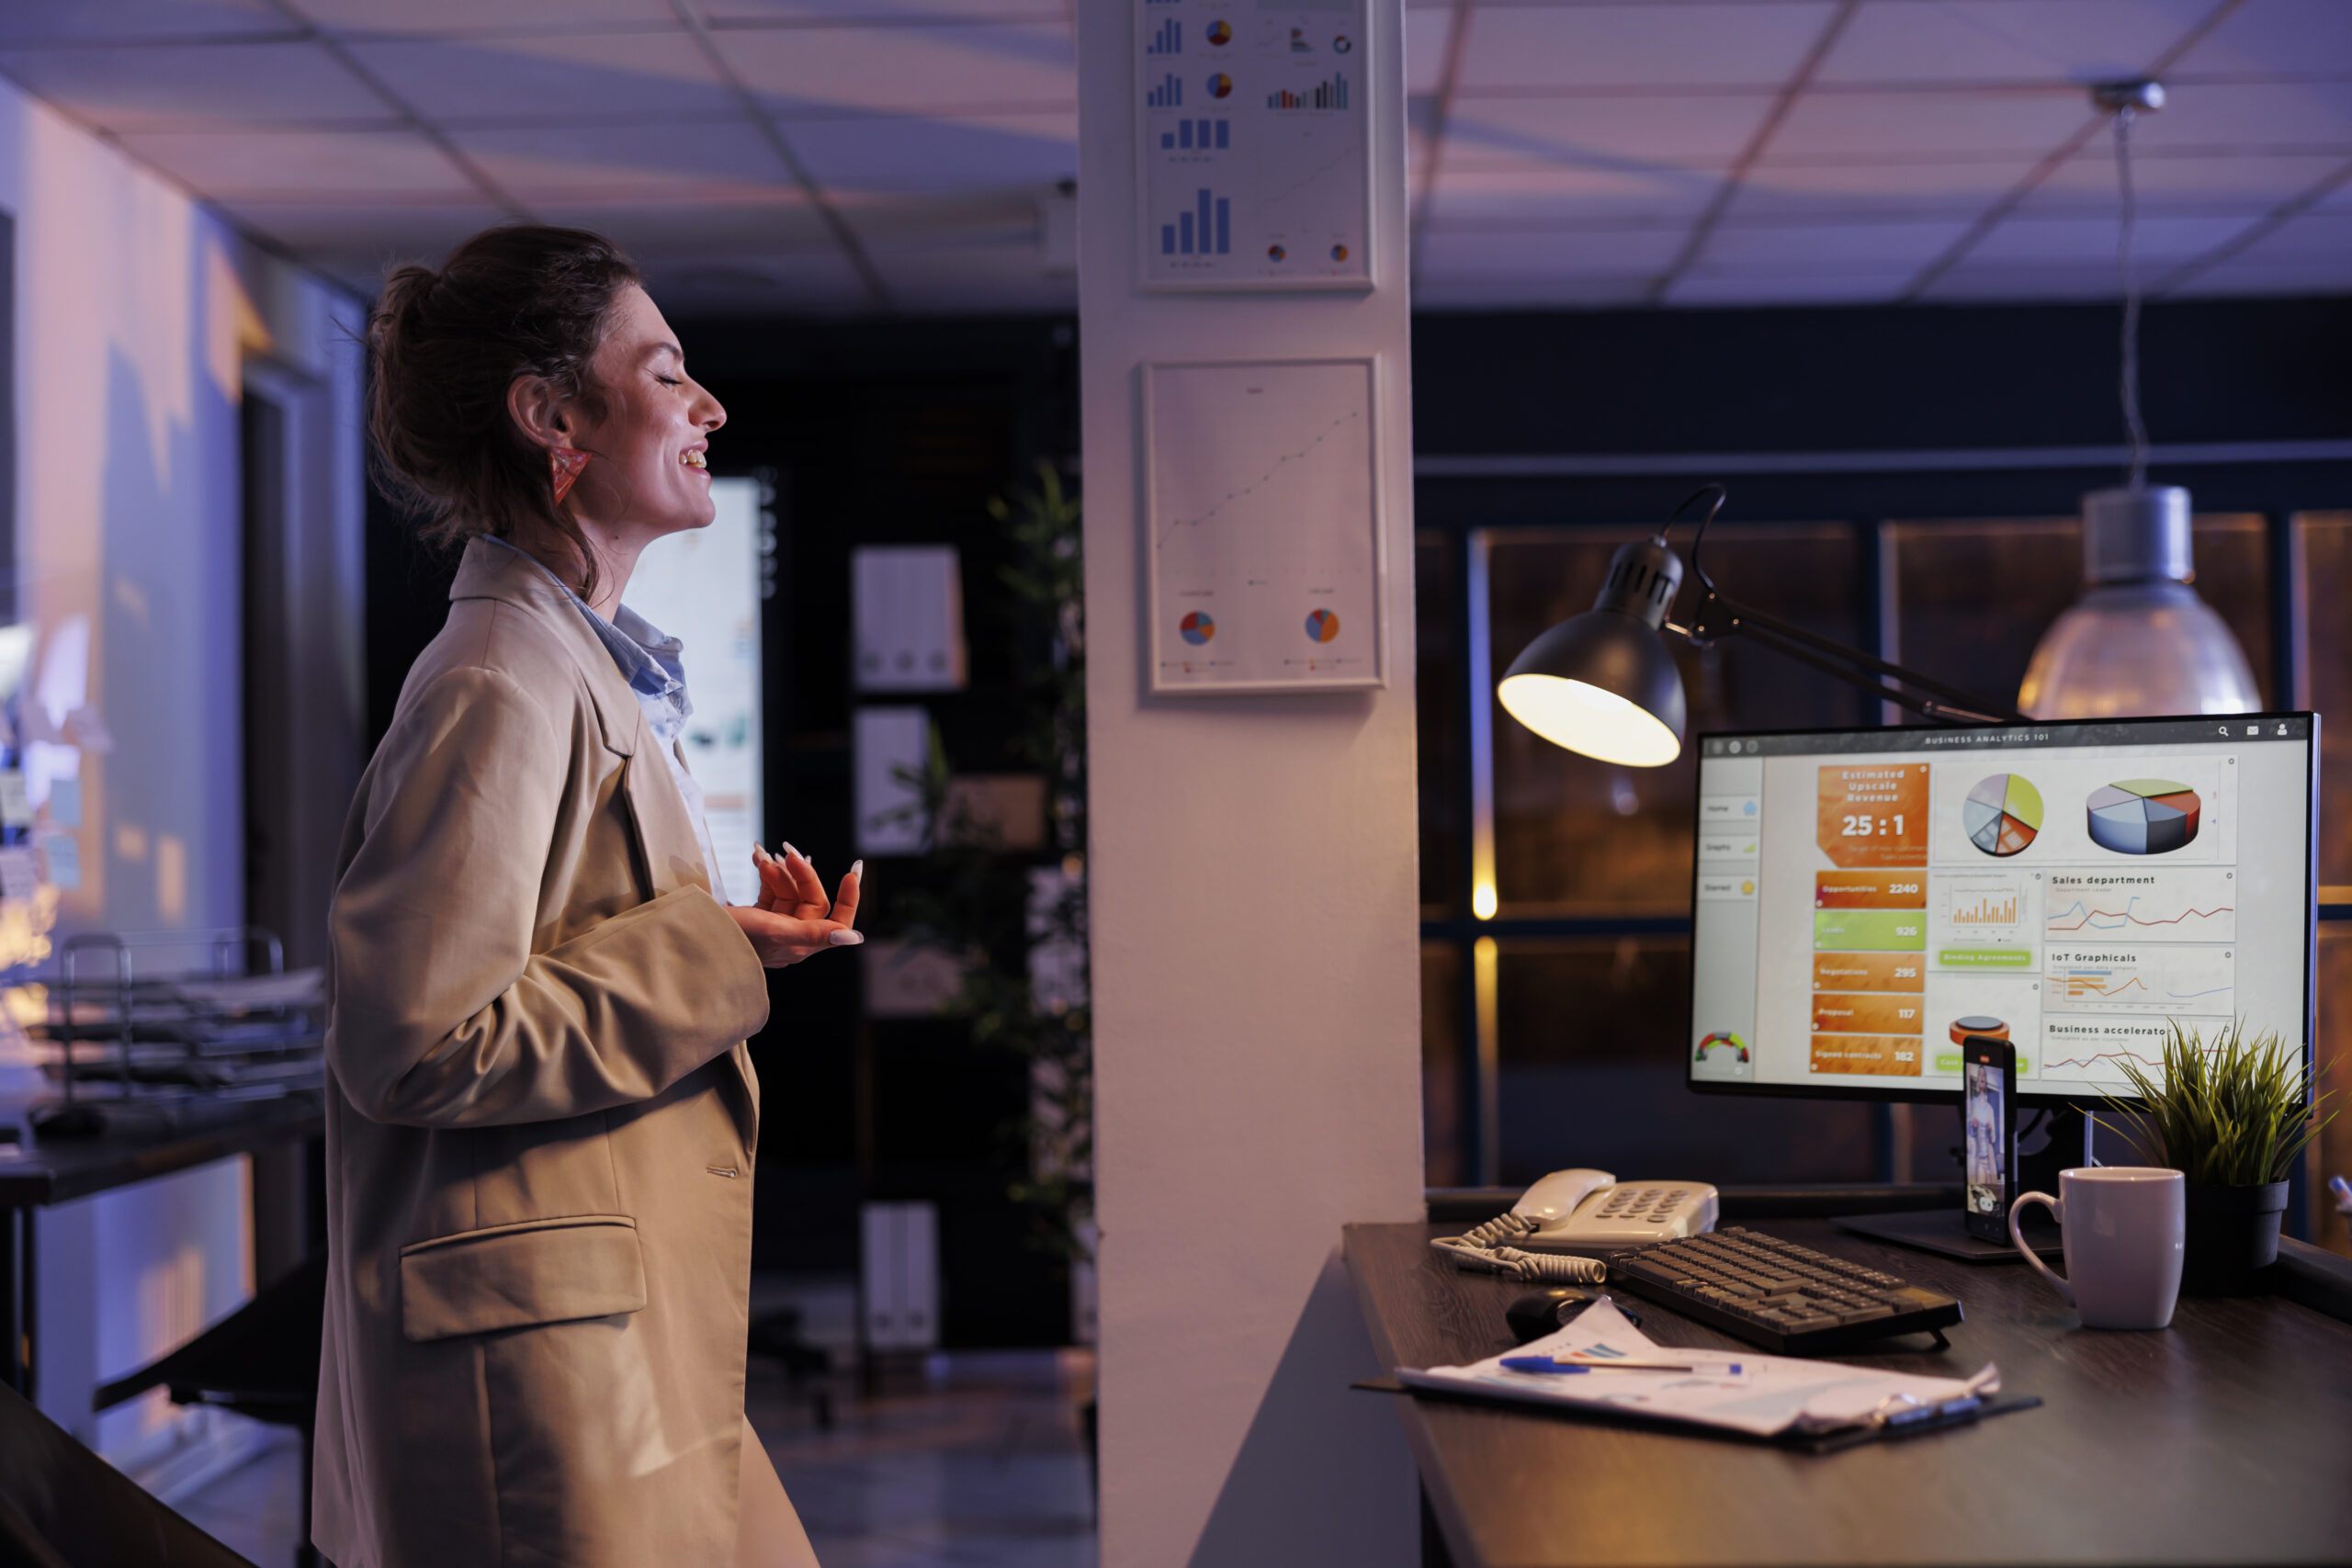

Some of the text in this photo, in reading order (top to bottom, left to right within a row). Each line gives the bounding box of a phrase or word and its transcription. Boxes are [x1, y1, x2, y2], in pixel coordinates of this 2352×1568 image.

[1926, 733, 2049, 744] BUSINESS ANALYTICS 101
[1841, 770, 1905, 780] Estimated
[1849, 782, 1897, 793] Upscale
[1847, 793, 1898, 802] Revenue
[1705, 843, 1731, 852] Graphs
[2052, 876, 2154, 886] Sales department
[1822, 884, 1918, 894] Opportunities 2240
[1895, 926, 1917, 936] 926
[1943, 954, 2026, 963] Binding Agreements
[2052, 953, 2136, 964] IoT Graphicals
[1894, 967, 1917, 977] 295
[1818, 1008, 1915, 1019] Proposal 117
[2049, 1025, 2099, 1034] Business
[1815, 1050, 1842, 1059] Signed
[1894, 1051, 1914, 1062] 182
[1939, 1058, 1959, 1066] Cost
